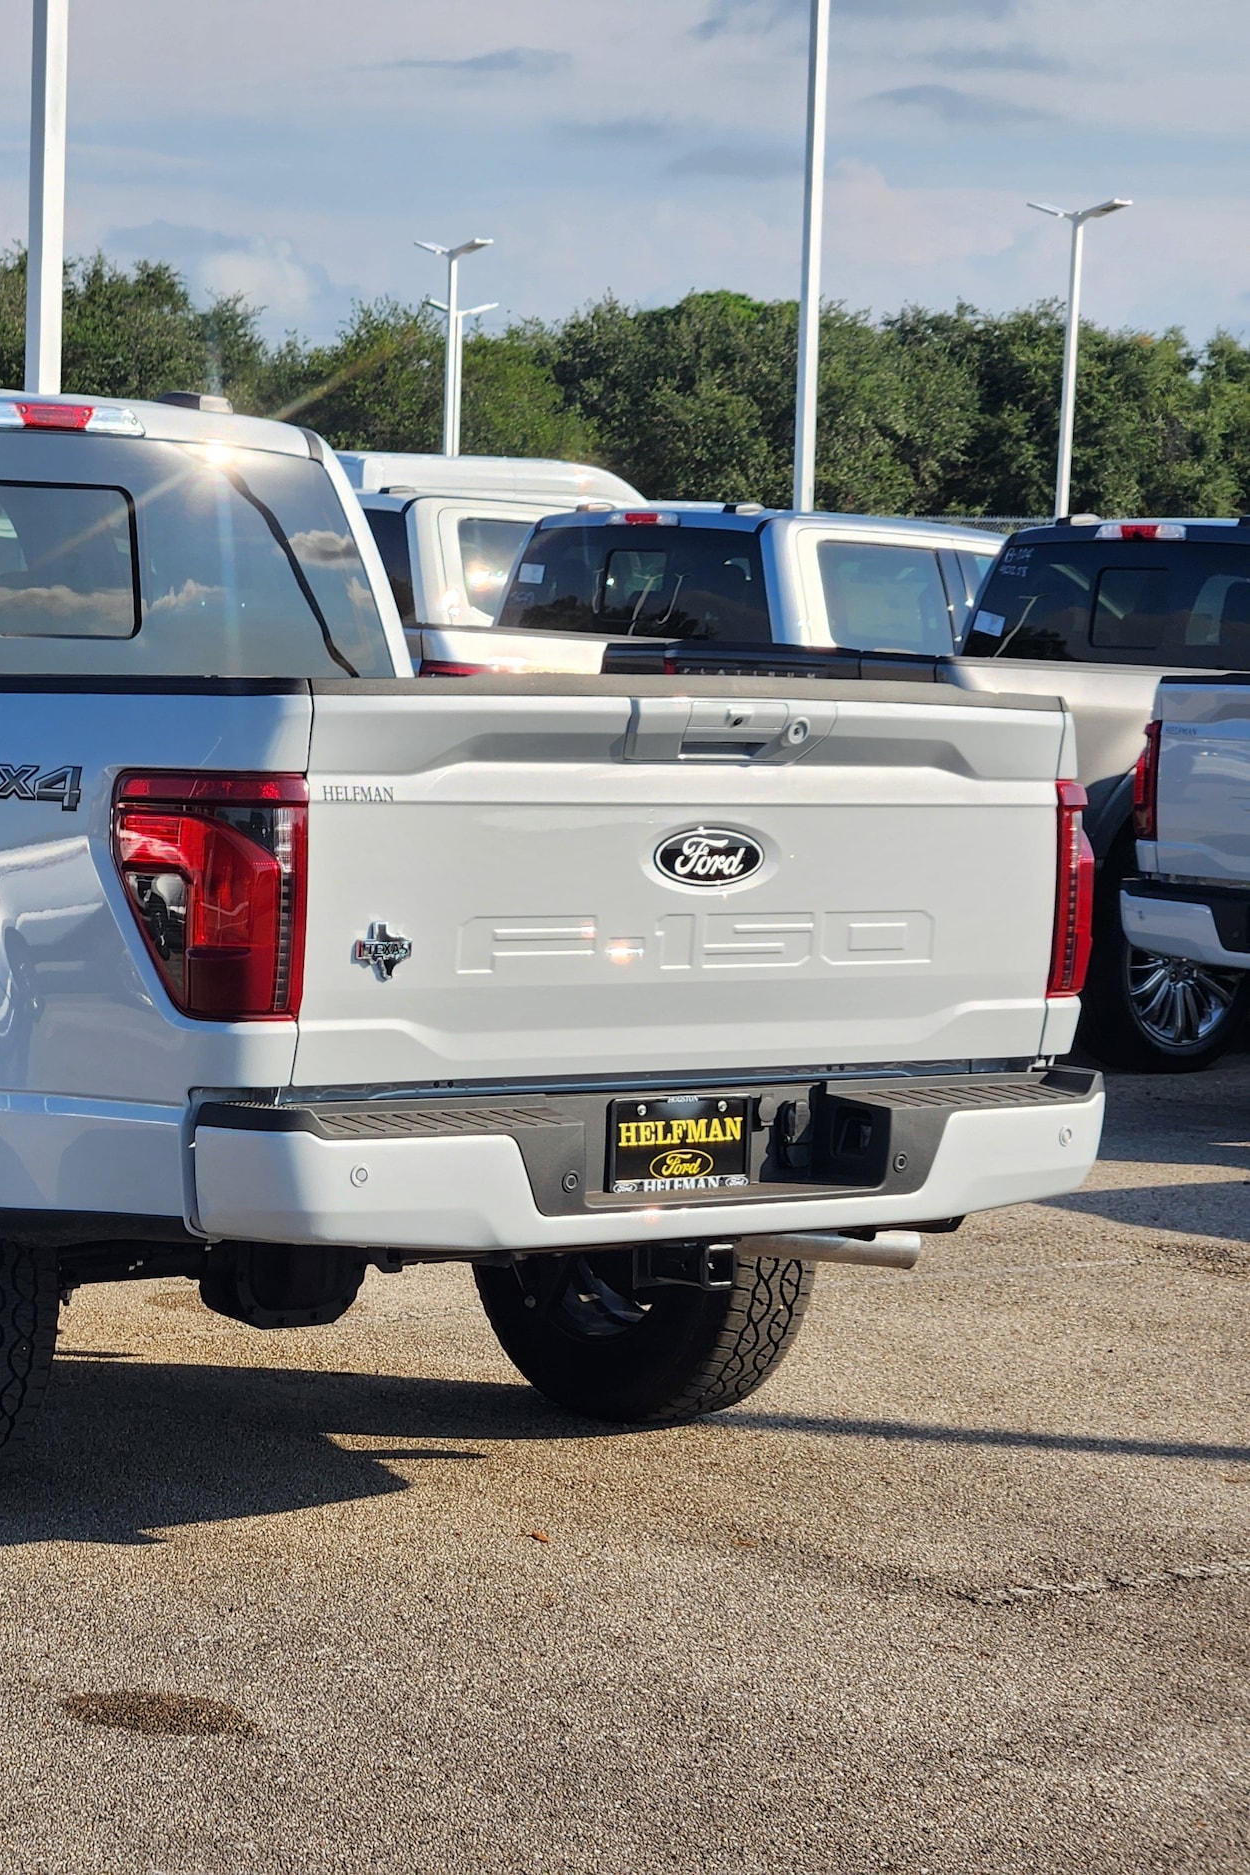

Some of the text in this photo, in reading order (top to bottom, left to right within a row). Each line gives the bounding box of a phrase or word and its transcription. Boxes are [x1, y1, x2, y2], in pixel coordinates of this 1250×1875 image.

[322, 785, 394, 802] HELFMAN
[675, 836, 746, 876] Ford
[364, 942, 410, 957] TEXAS
[456, 912, 936, 974] F-150
[618, 1116, 744, 1147] HELFMAN
[661, 1153, 703, 1176] Ford
[643, 1176, 720, 1193] HELFMAN
